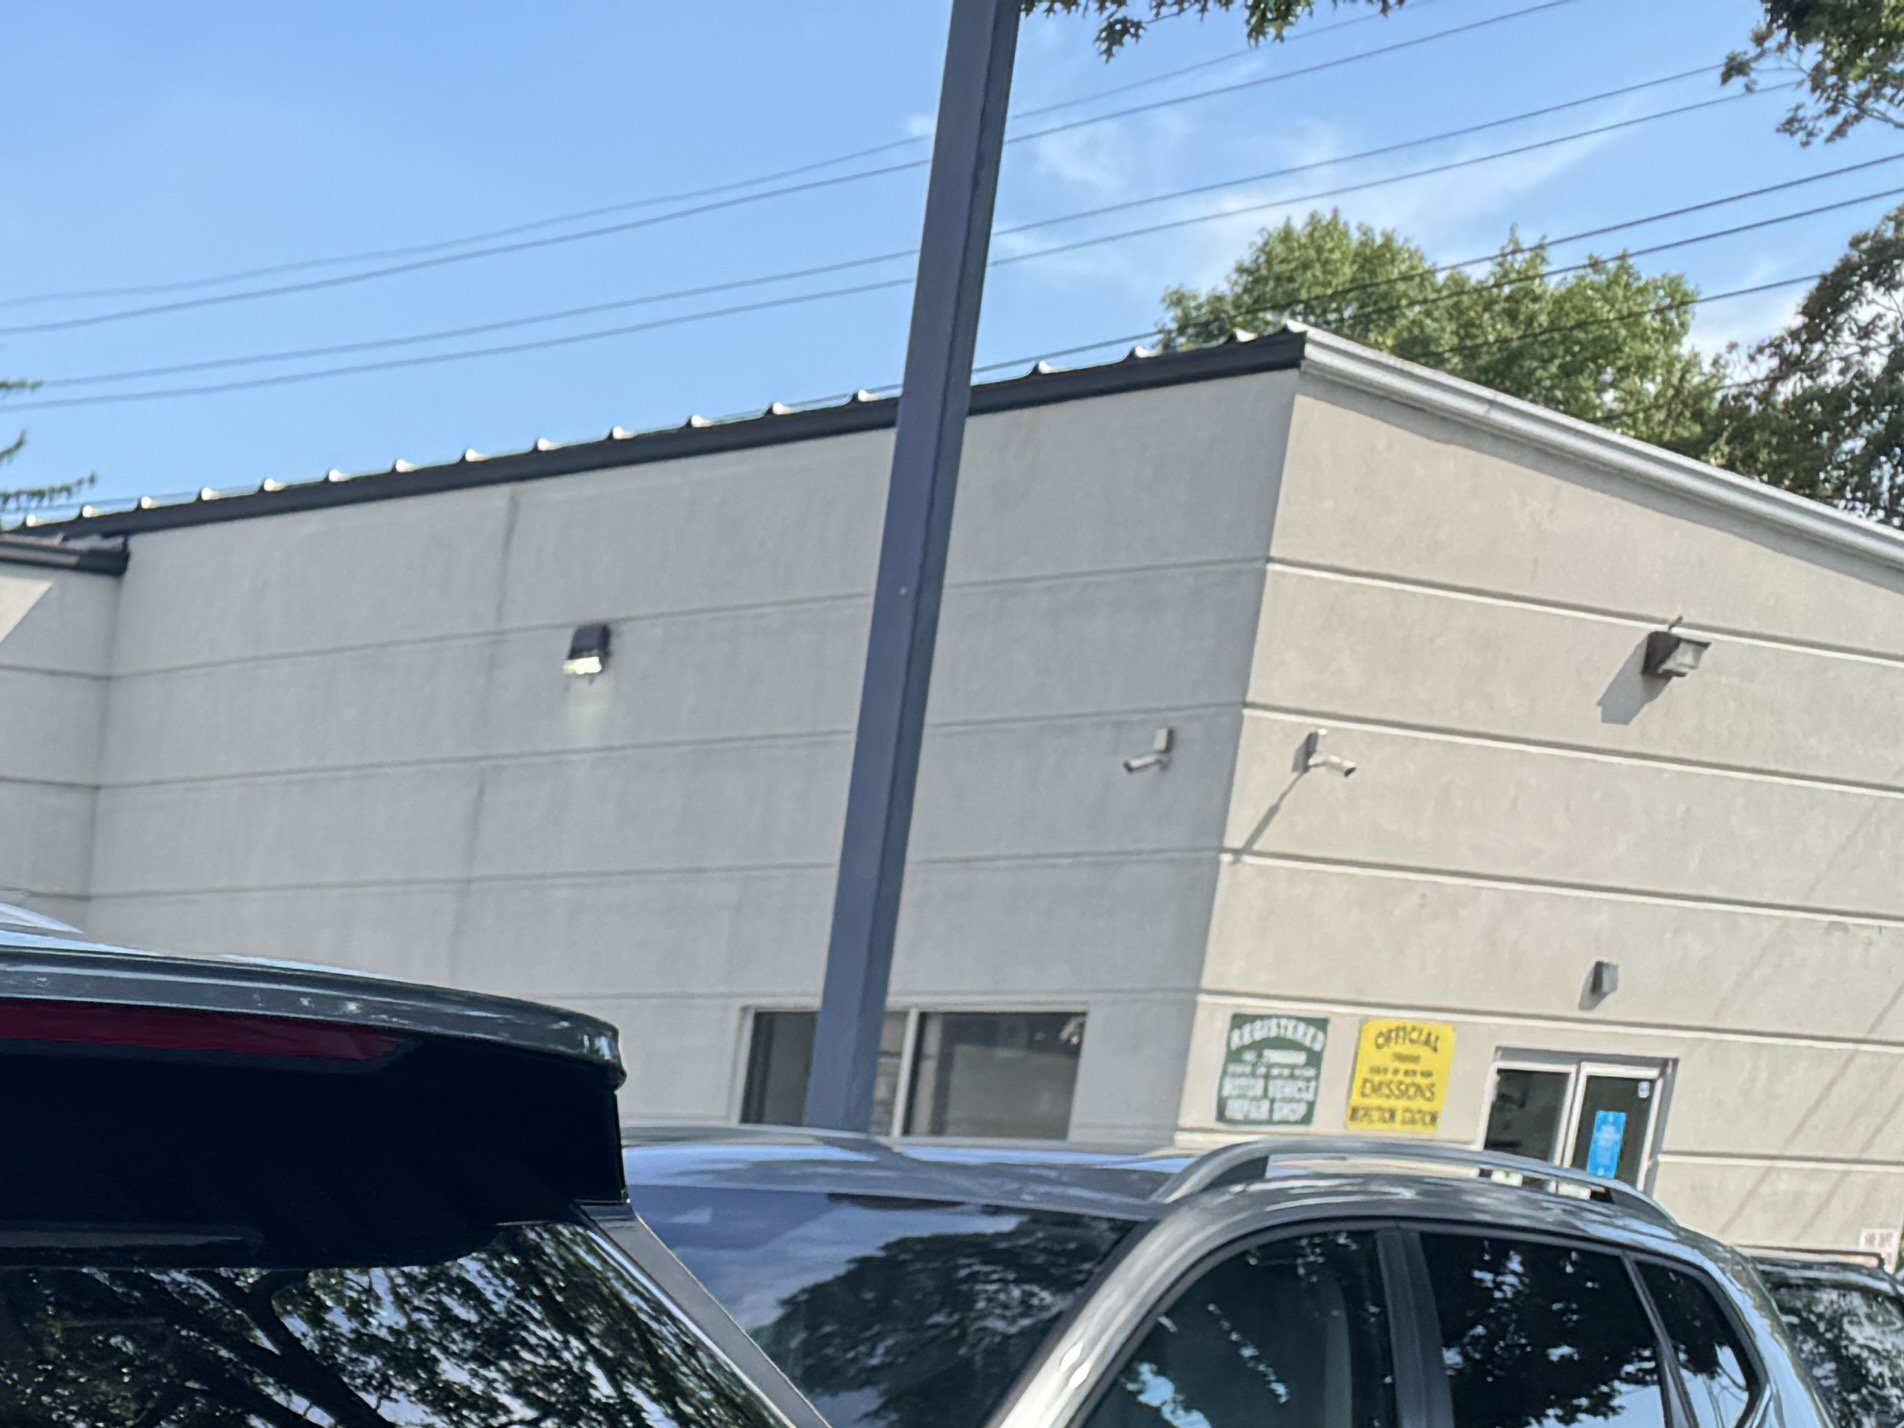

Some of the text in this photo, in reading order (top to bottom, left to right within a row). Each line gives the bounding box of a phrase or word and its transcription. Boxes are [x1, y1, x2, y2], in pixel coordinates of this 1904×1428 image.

[1230, 1018, 1324, 1052] REGISTERED
[1375, 1024, 1440, 1053] OFFICIAL
[1361, 1077, 1436, 1102] EMISSIONS
